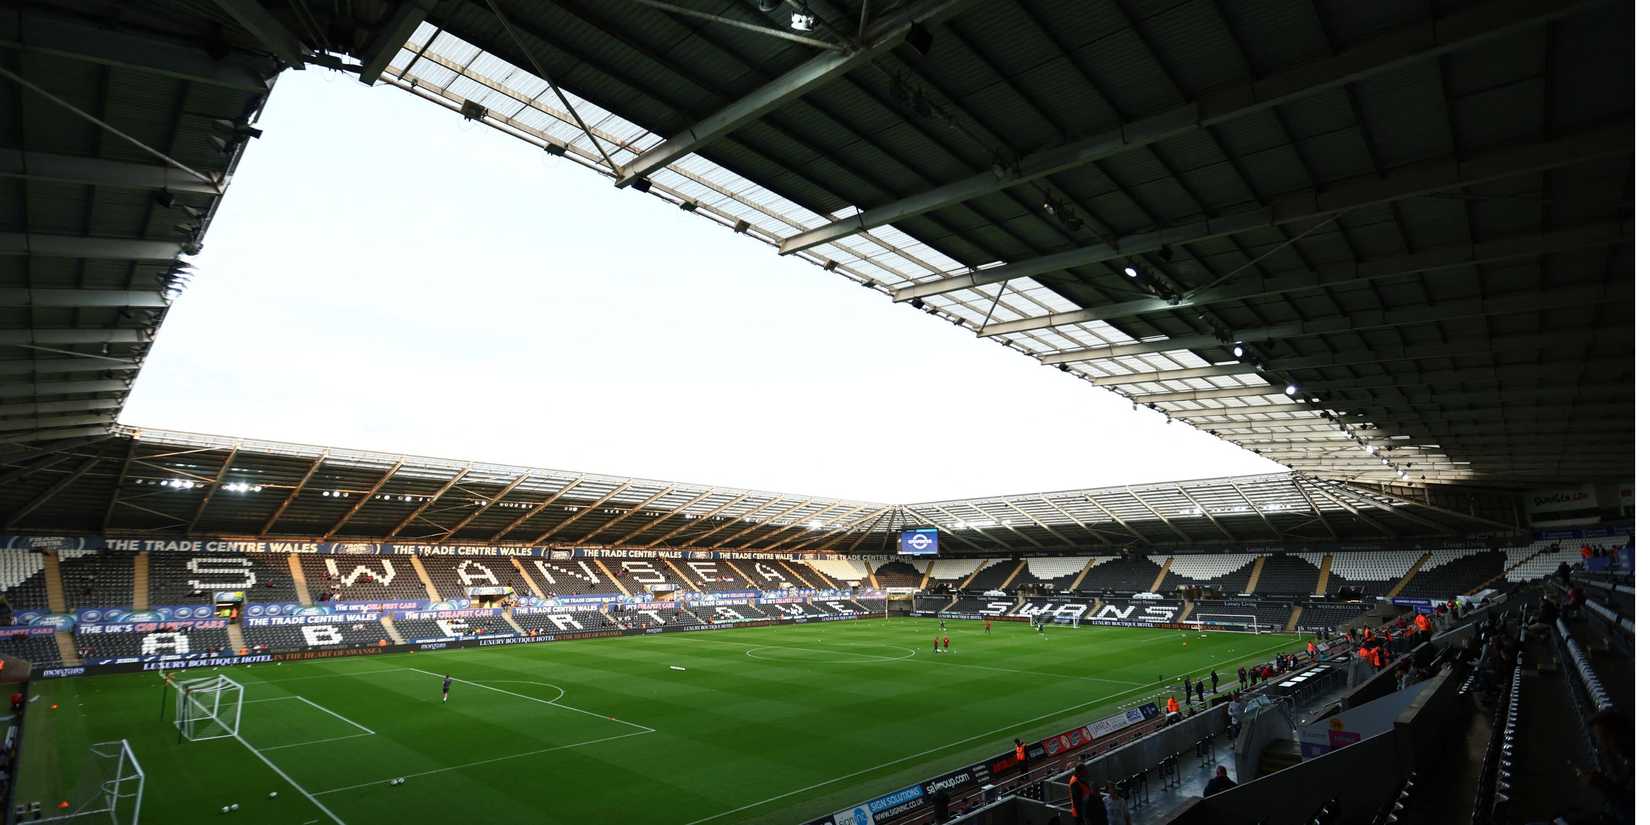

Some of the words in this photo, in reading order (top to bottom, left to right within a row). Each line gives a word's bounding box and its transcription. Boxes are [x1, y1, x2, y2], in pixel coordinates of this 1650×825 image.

[105, 540, 139, 550] THE
[144, 540, 202, 552] TRADE
[206, 541, 266, 552] CENTRE
[270, 542, 318, 553] WALES
[393, 545, 414, 554] THE
[418, 546, 456, 555] TRADE
[458, 546, 497, 556] CENTRE
[500, 547, 532, 556] WALES
[601, 550, 626, 558] TRADE
[248, 618, 268, 626] THE
[271, 617, 305, 625] TRADE
[307, 616, 344, 624] CENTRE
[346, 614, 377, 622] WALES
[438, 610, 473, 618] CHEAPEST
[80, 625, 102, 634] THE
[105, 624, 133, 633] UK'S
[195, 620, 225, 629] CARS
[144, 660, 185, 670] LUXURY
[188, 657, 239, 668] BOUTIQUE
[241, 654, 272, 663] HOTEL
[870, 800, 886, 811] SIGN
[887, 787, 921, 806] SOLUTIONS
